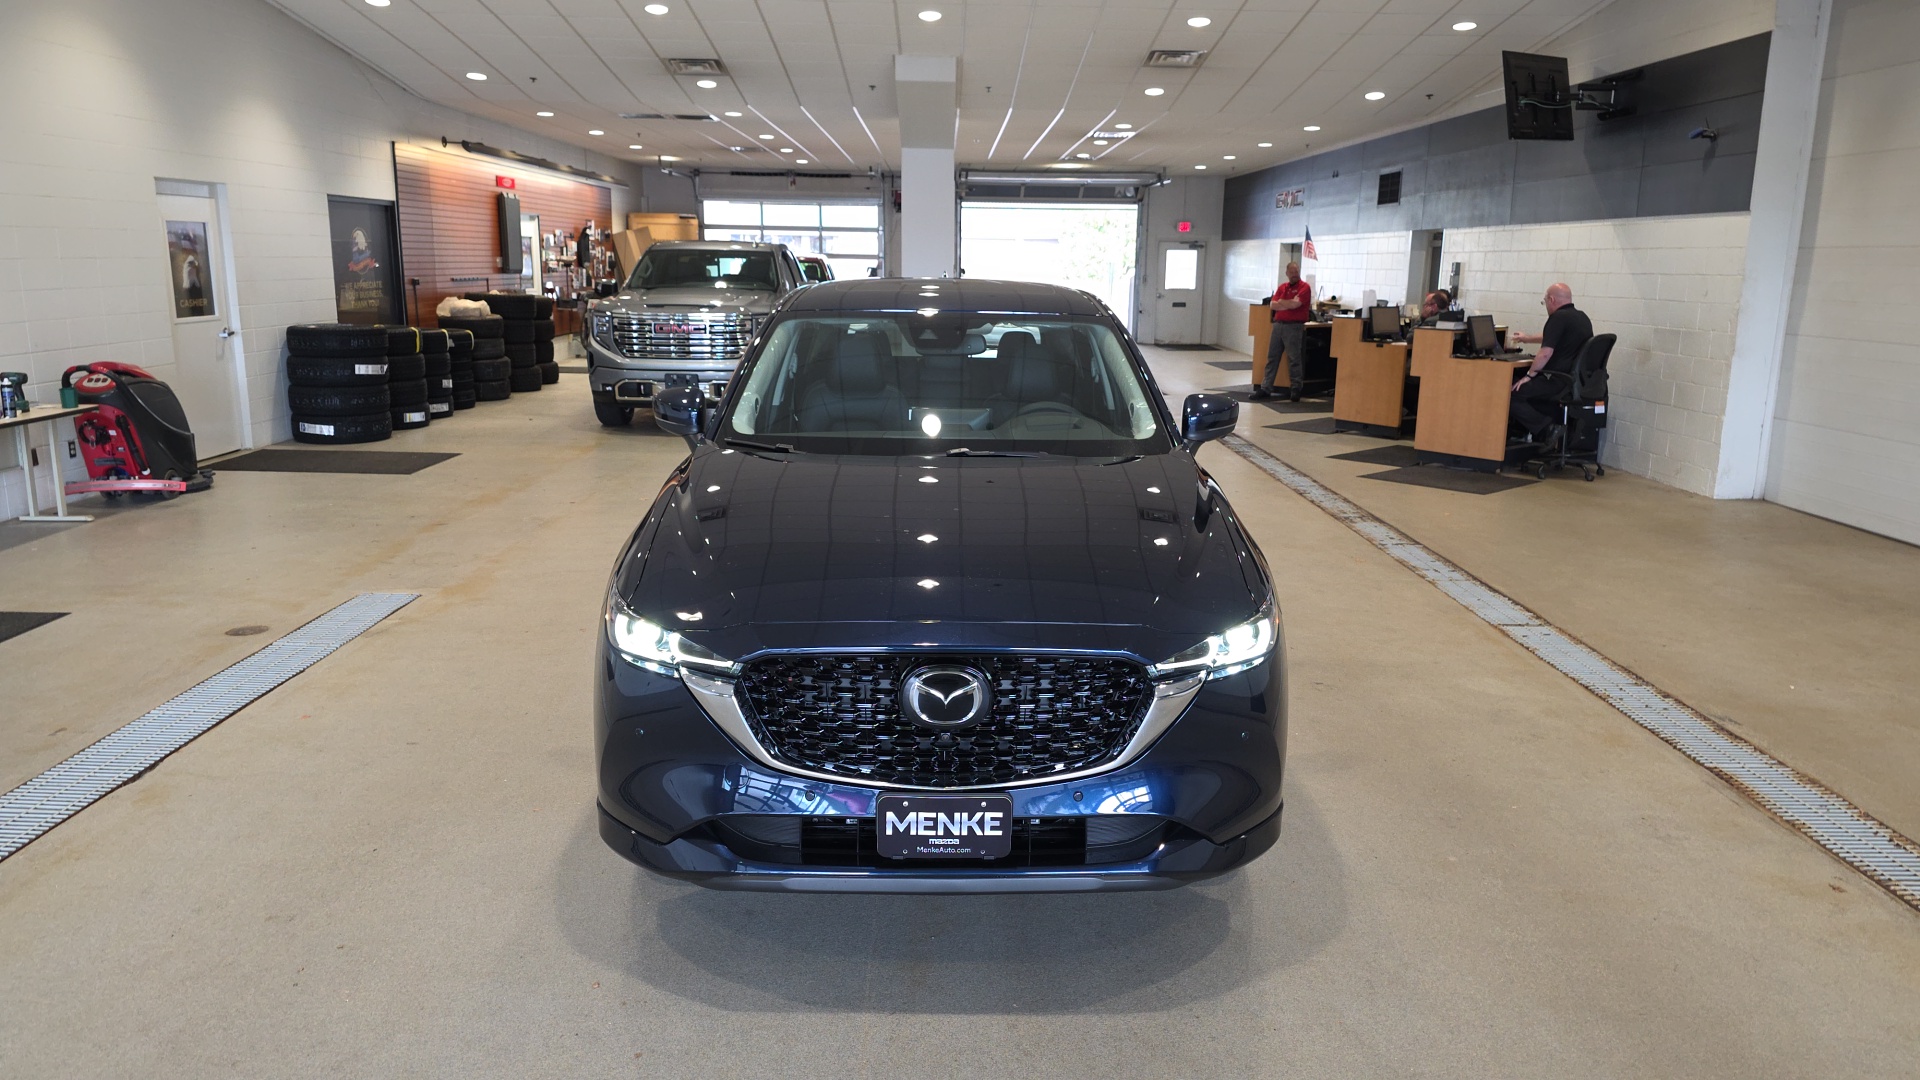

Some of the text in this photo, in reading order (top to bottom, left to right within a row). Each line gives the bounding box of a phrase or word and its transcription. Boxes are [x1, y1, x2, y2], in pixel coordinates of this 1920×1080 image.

[1275, 187, 1305, 209] GMC
[180, 298, 207, 307] CASHIER
[655, 324, 706, 334] GMC
[885, 811, 1004, 836] MENKE
[916, 846, 972, 854] MenkeAuto.com
